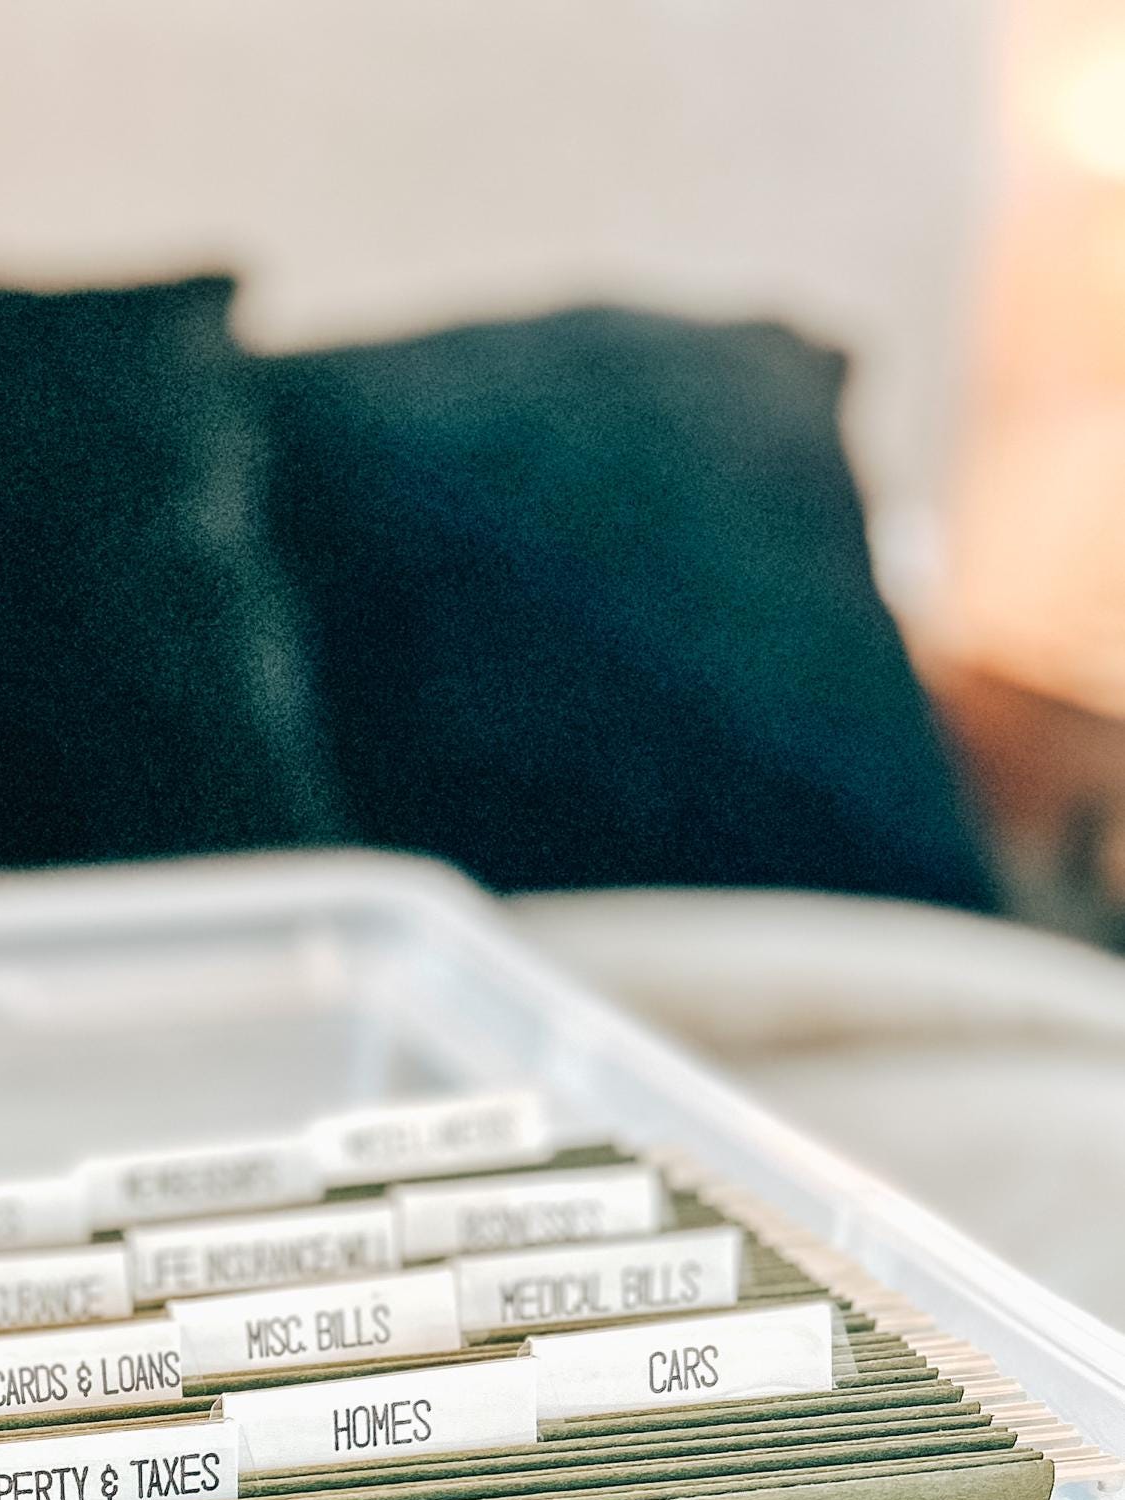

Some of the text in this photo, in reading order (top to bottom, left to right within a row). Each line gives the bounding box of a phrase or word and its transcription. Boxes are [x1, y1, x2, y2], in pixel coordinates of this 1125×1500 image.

[499, 1262, 702, 1322] MEDICAL BILLS
[247, 1304, 391, 1361] MISC. BILLS
[77, 1363, 92, 1398] &
[102, 1350, 180, 1395] LOANS
[648, 1346, 719, 1394] CARS
[333, 1401, 432, 1452] HOMES
[131, 1452, 220, 1500] TAXES
